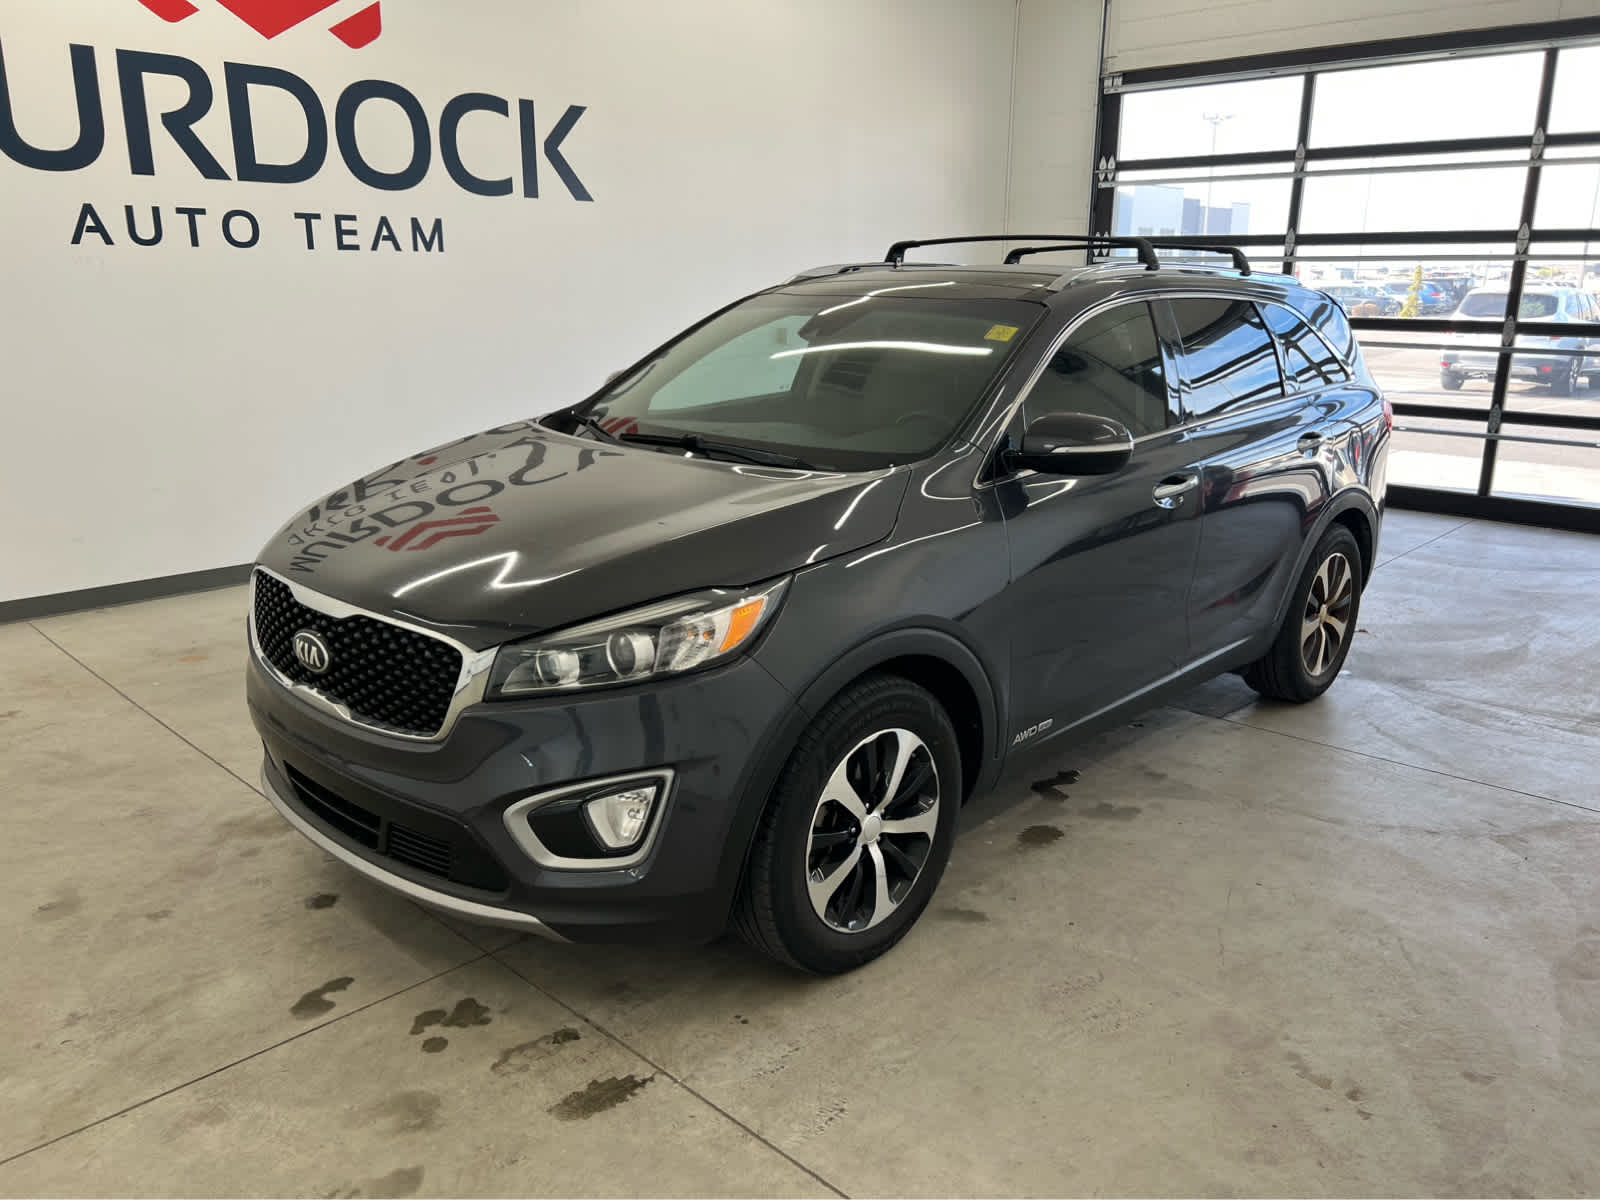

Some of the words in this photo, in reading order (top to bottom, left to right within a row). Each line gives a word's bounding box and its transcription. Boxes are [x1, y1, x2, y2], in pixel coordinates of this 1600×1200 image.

[0, 38, 595, 203] URDOCK
[70, 202, 262, 249] AUTO
[293, 211, 446, 253] TEAM
[295, 637, 322, 668] KIA
[1012, 725, 1038, 746] AWD
